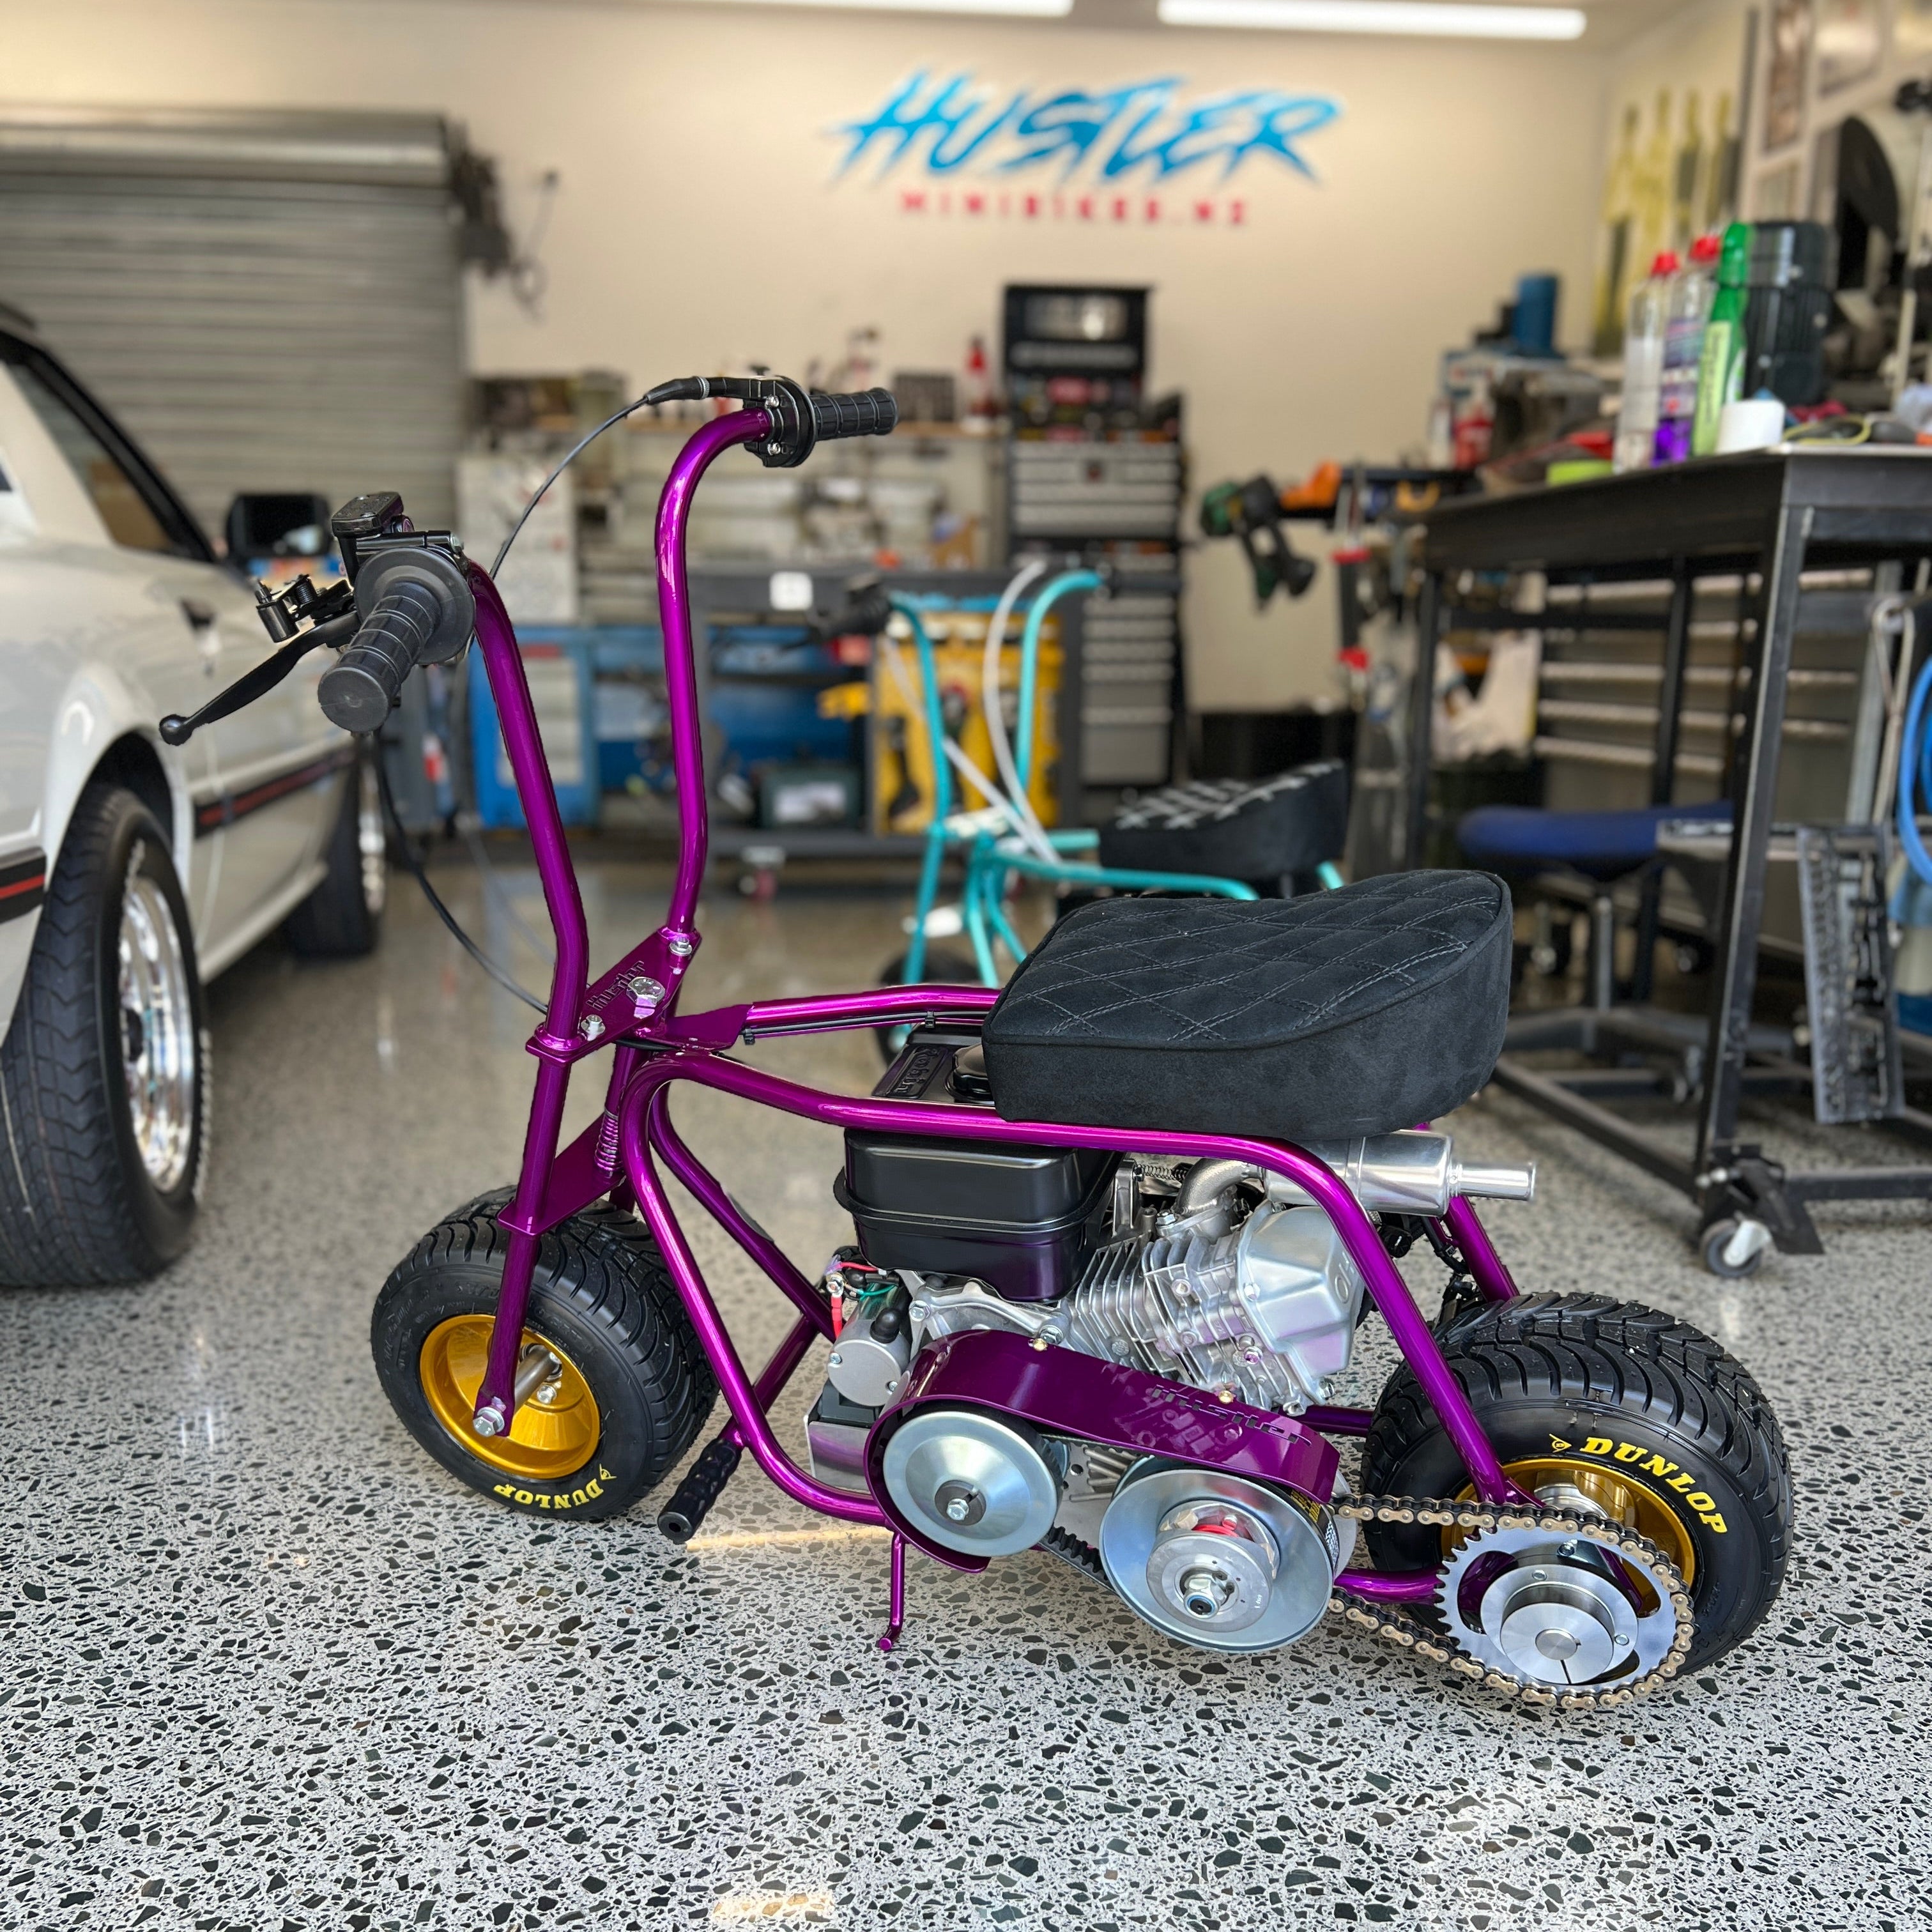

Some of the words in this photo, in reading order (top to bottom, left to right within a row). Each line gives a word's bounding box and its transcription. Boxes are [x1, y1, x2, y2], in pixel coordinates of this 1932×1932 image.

[824, 70, 1343, 185] HUSTLER
[493, 1478, 604, 1510] DUNLOP
[1579, 1437, 1728, 1533] DUNLOP
